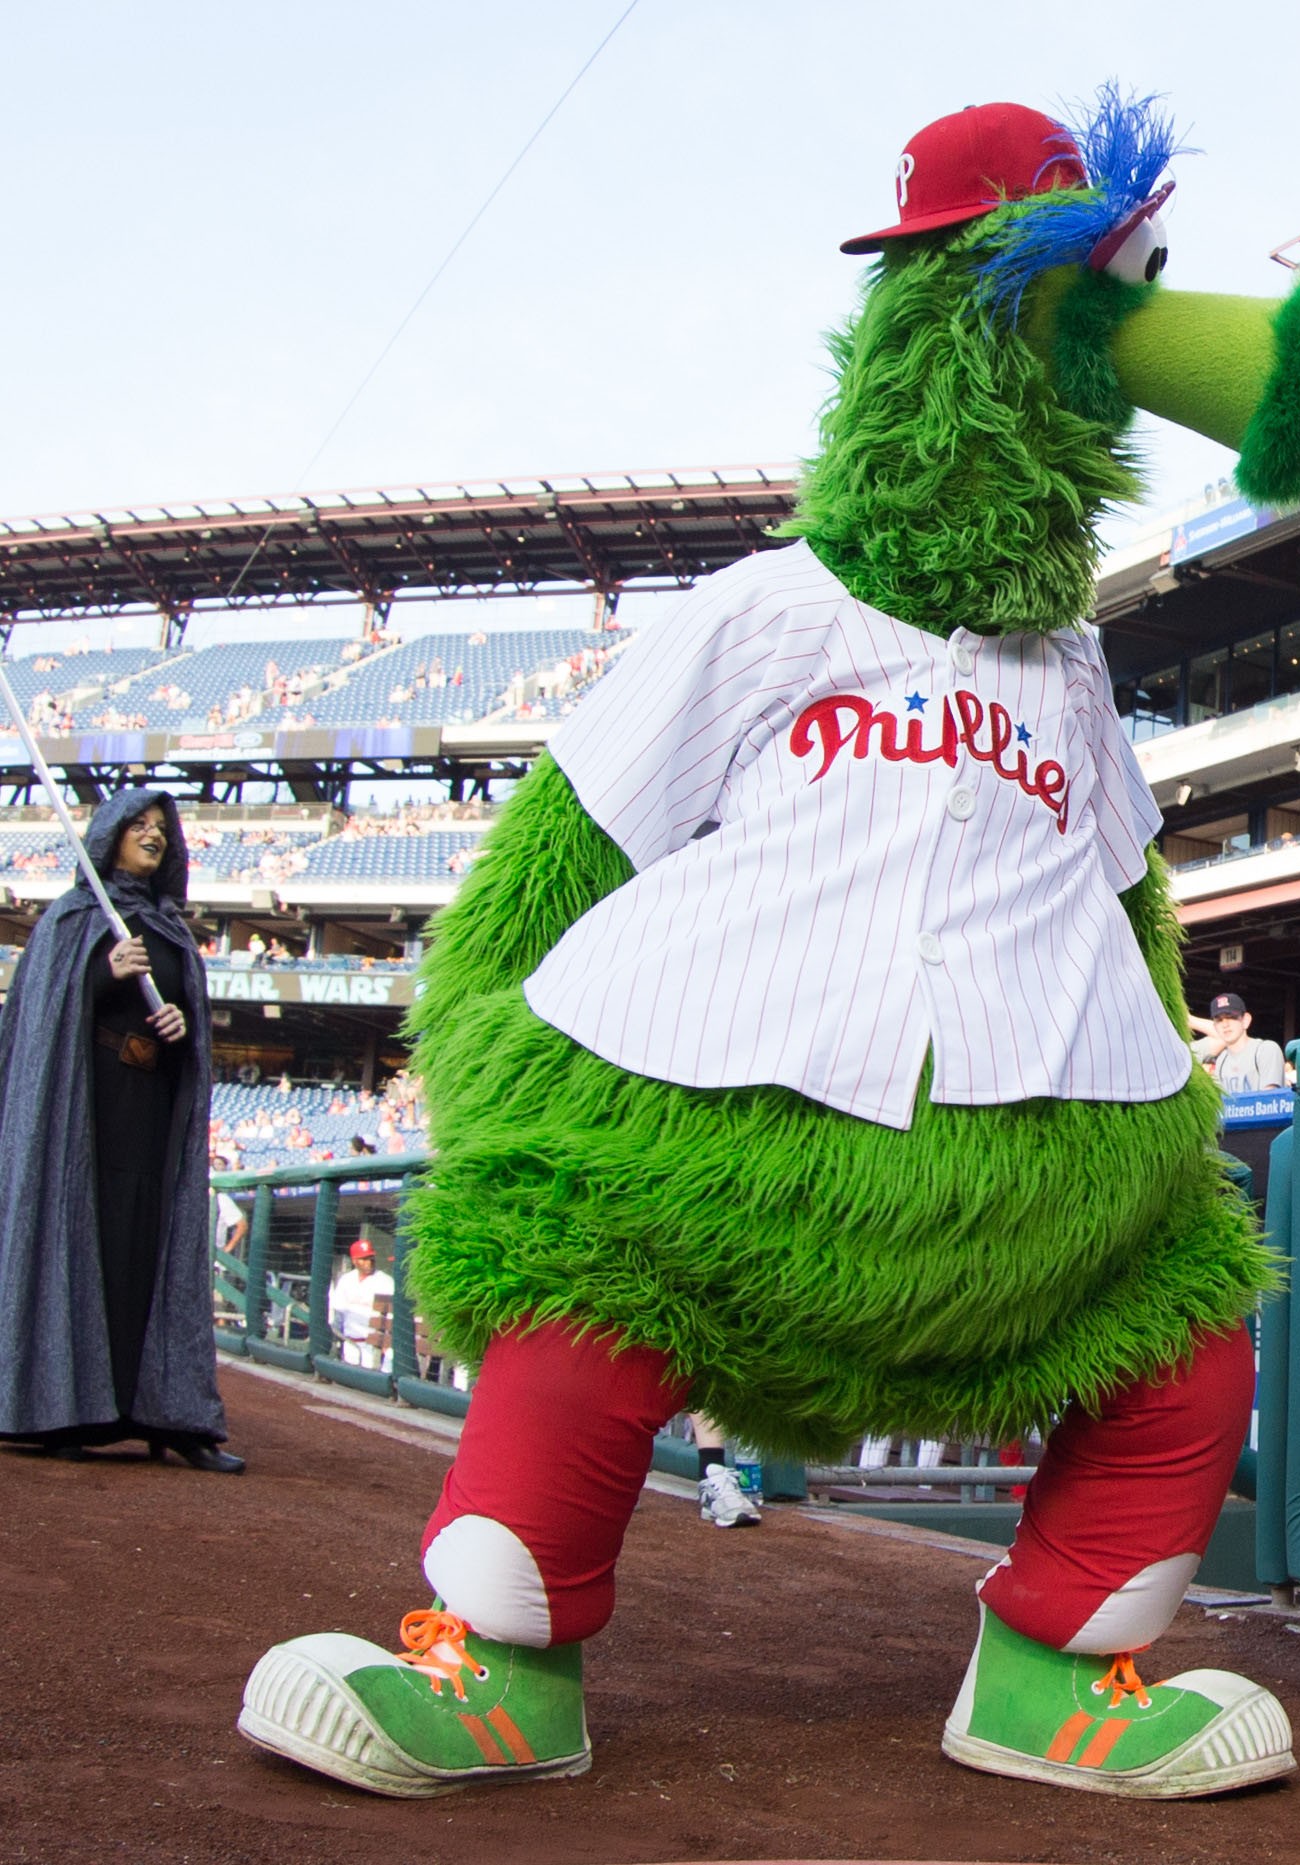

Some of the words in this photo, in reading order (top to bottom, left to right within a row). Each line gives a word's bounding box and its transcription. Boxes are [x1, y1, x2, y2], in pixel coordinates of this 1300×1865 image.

[895, 153, 915, 207] P
[300, 974, 394, 1003] WARS
[1225, 1104, 1254, 1118] itizens
[1256, 1100, 1279, 1115] Bank
[1280, 1098, 1294, 1113] Par
